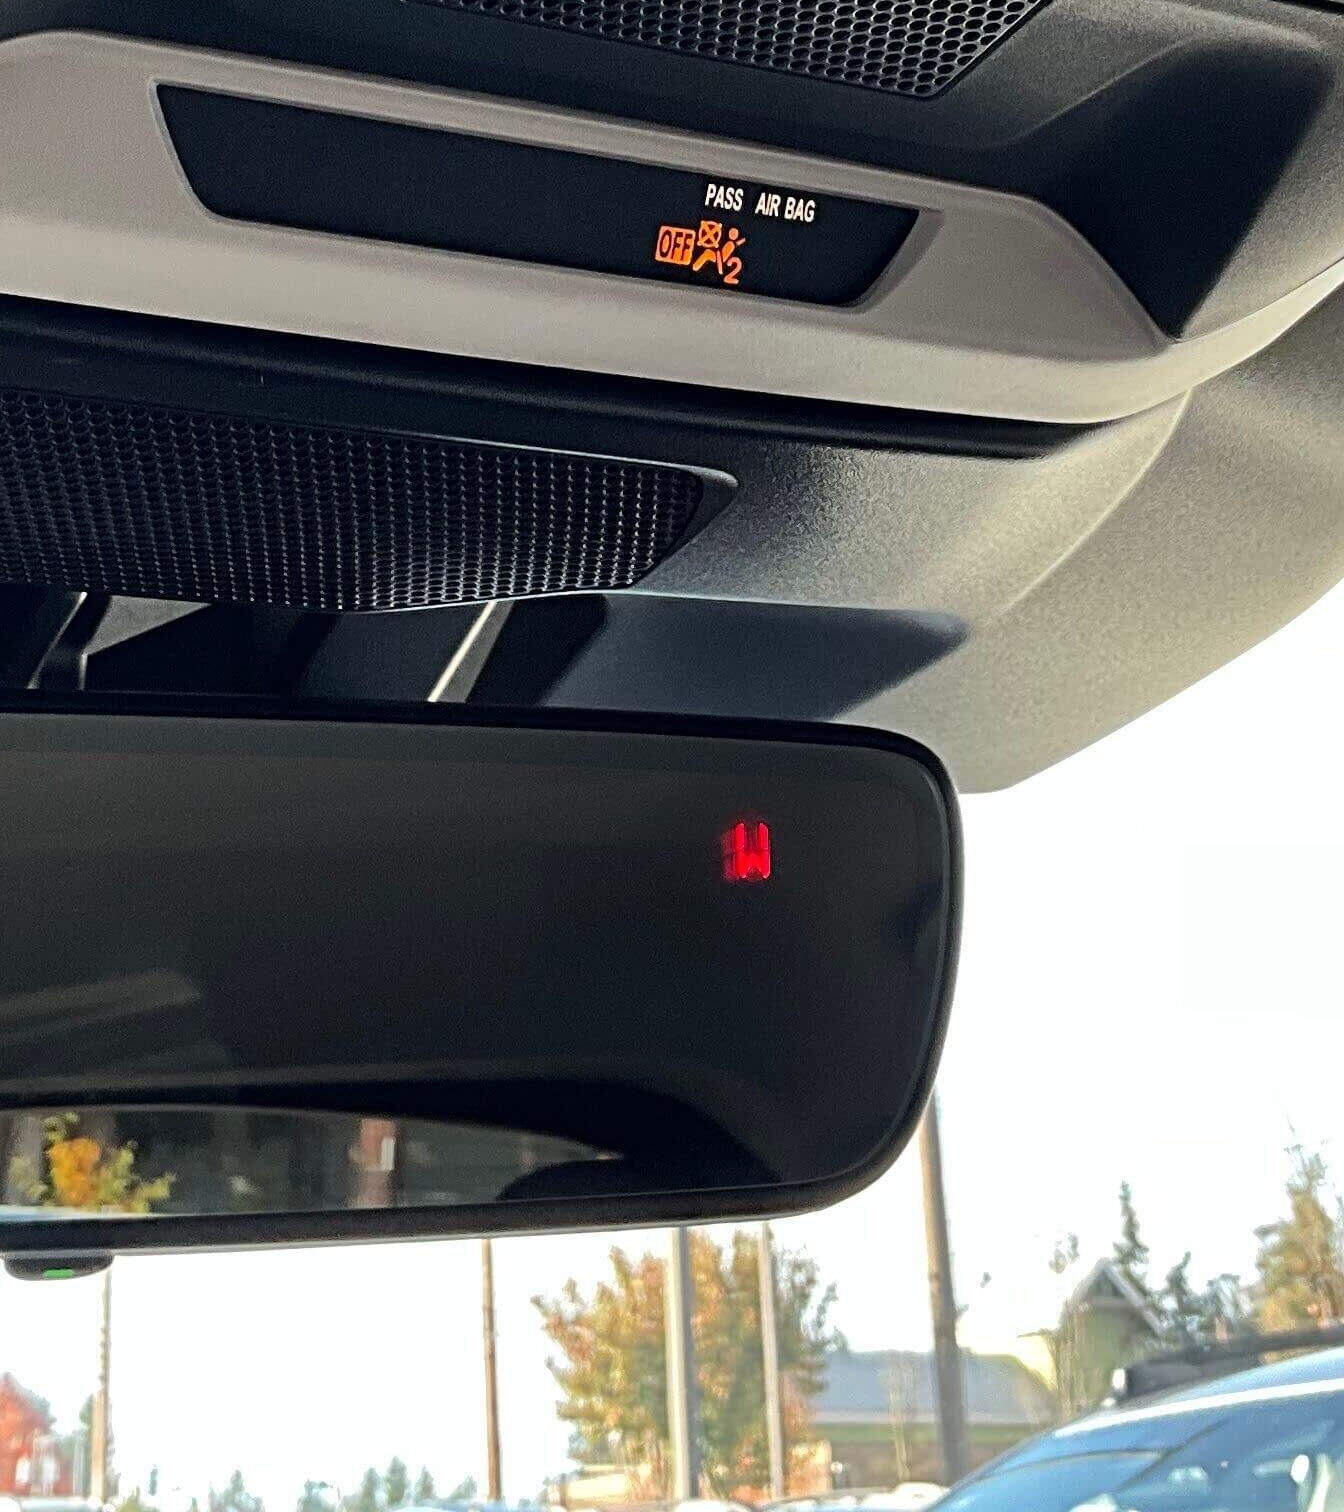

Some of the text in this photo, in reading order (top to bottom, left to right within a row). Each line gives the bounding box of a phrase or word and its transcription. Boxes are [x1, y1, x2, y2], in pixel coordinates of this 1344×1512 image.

[704, 183, 816, 223] PASS AIR BAG
[657, 228, 695, 262] OFF
[723, 255, 743, 285] 2
